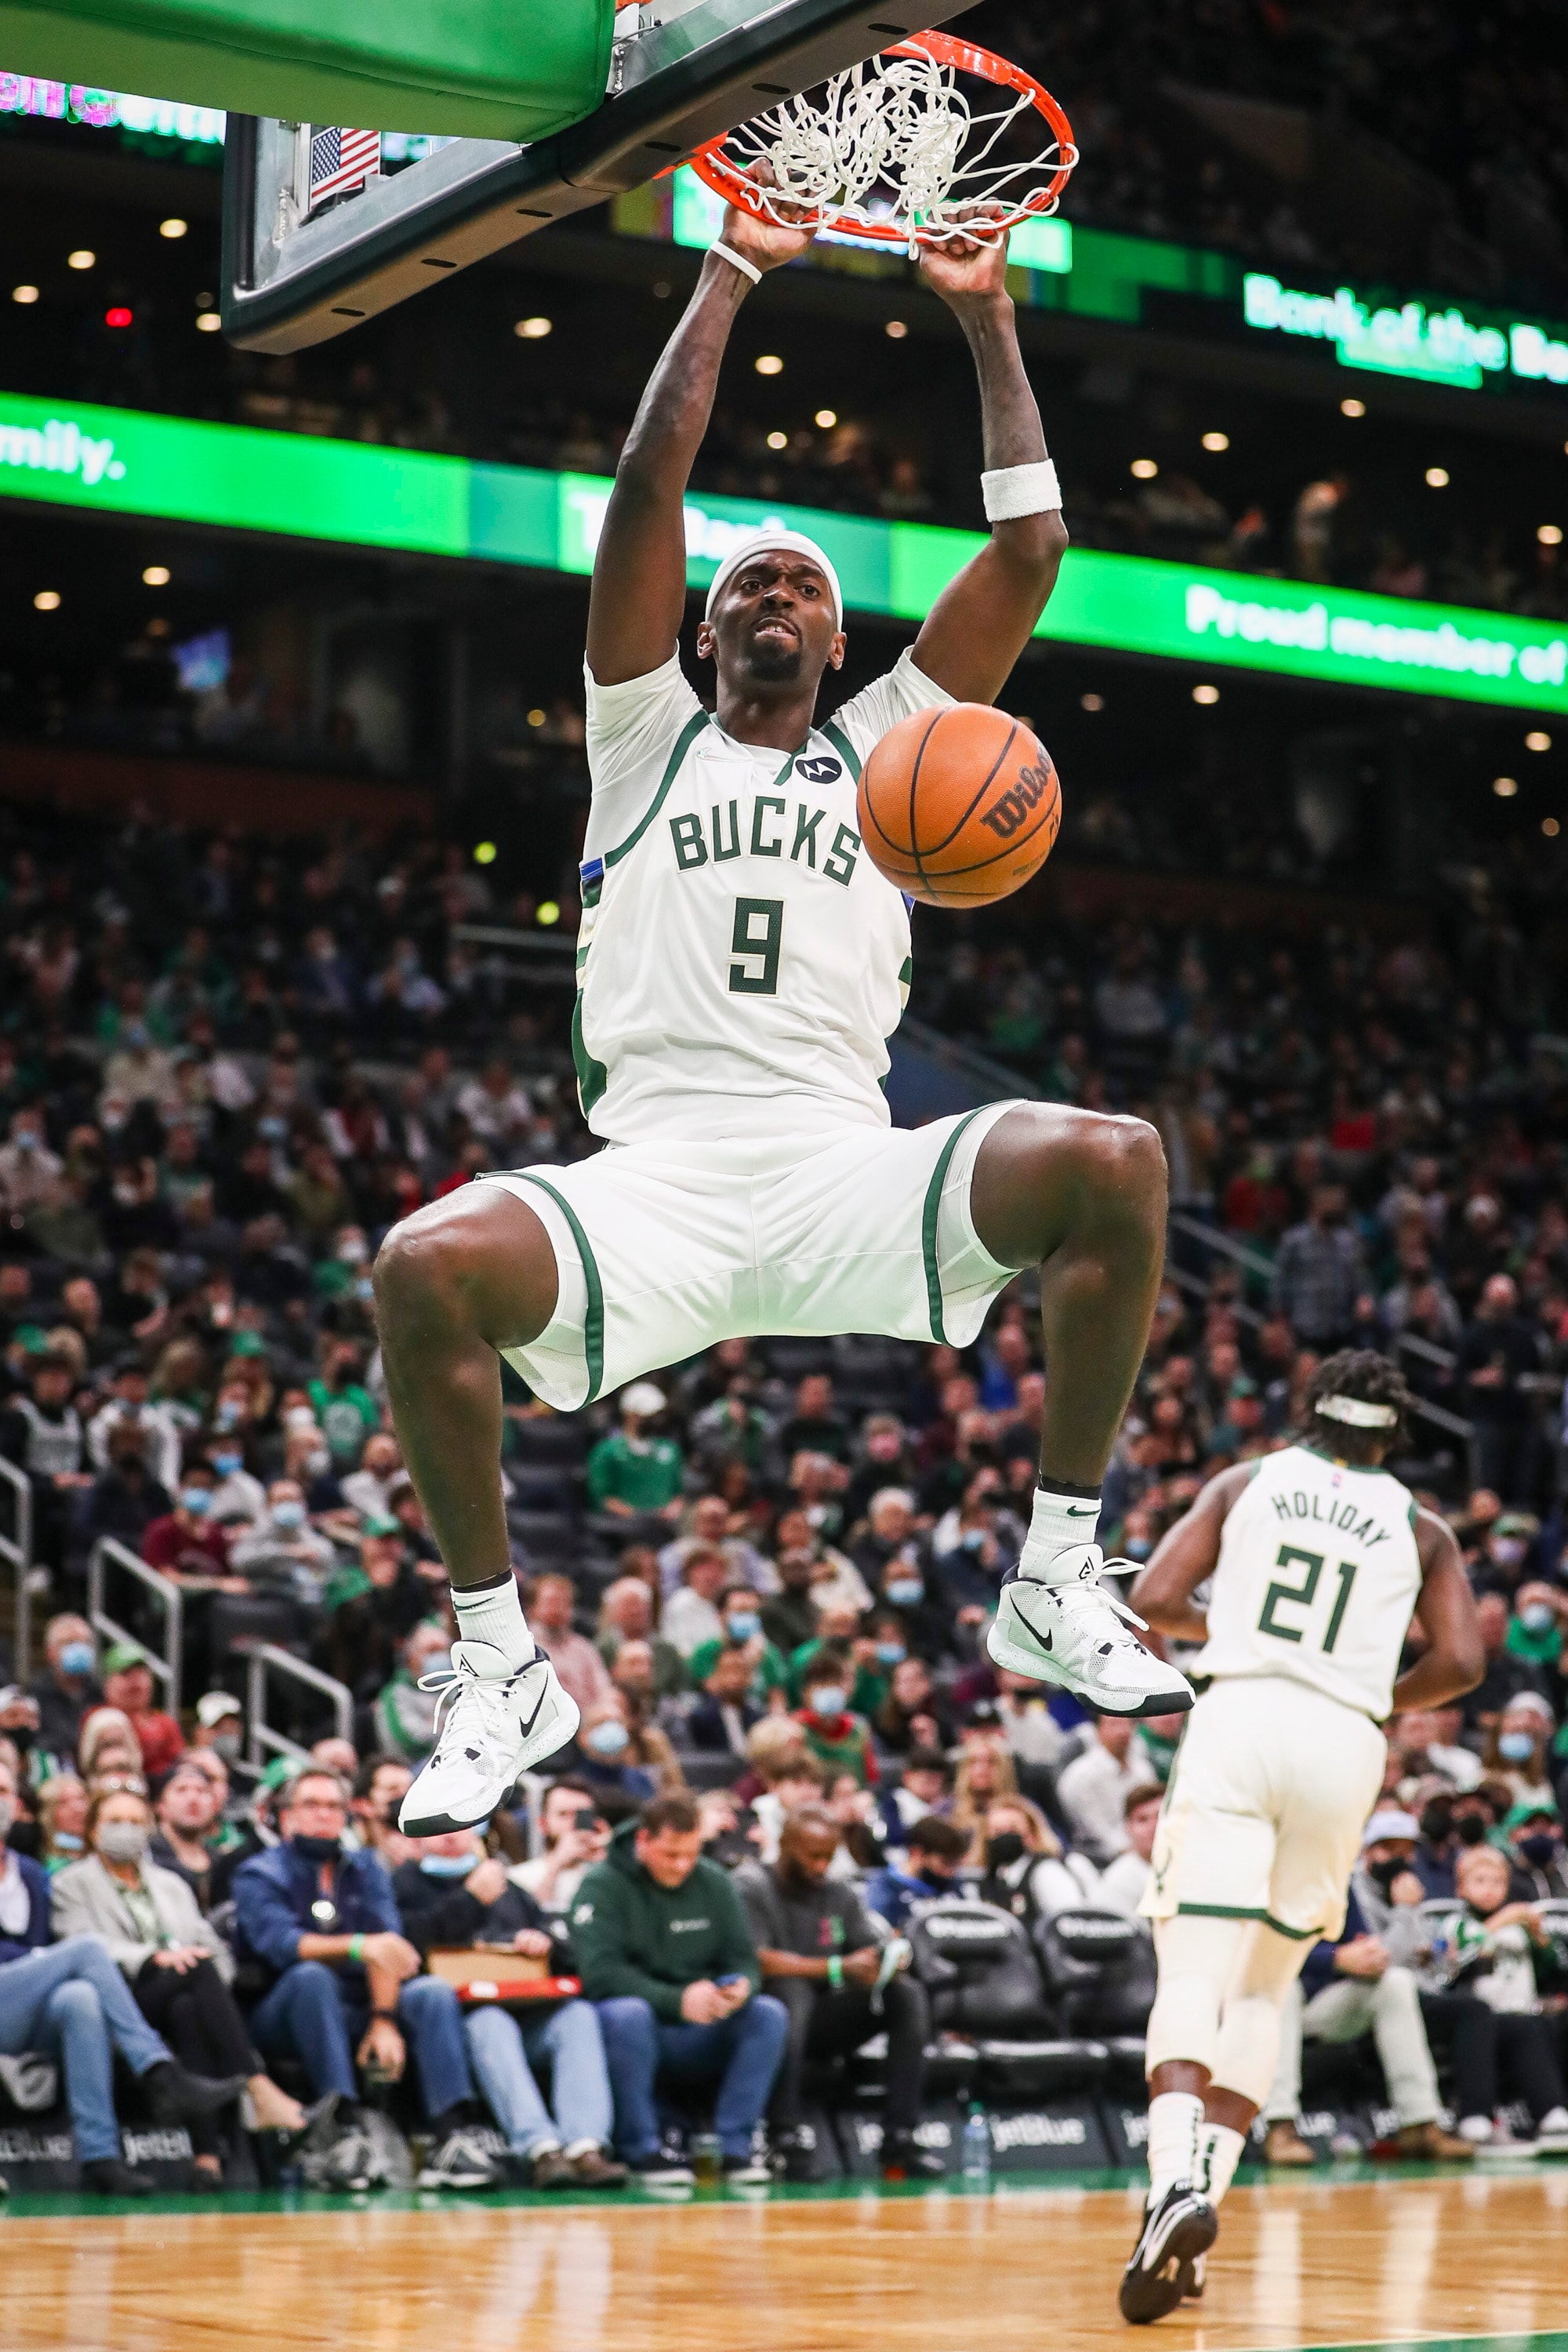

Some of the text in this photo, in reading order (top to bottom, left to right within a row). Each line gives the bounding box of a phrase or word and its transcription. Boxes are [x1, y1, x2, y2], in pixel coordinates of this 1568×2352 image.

[1243, 272, 1370, 347] Bank
[1185, 583, 1567, 686] Proud member of
[669, 795, 862, 889] BUCKS
[726, 895, 785, 1000] 9
[1271, 1491, 1391, 1548] HOLIDAY
[1258, 1543, 1357, 1654] 21
